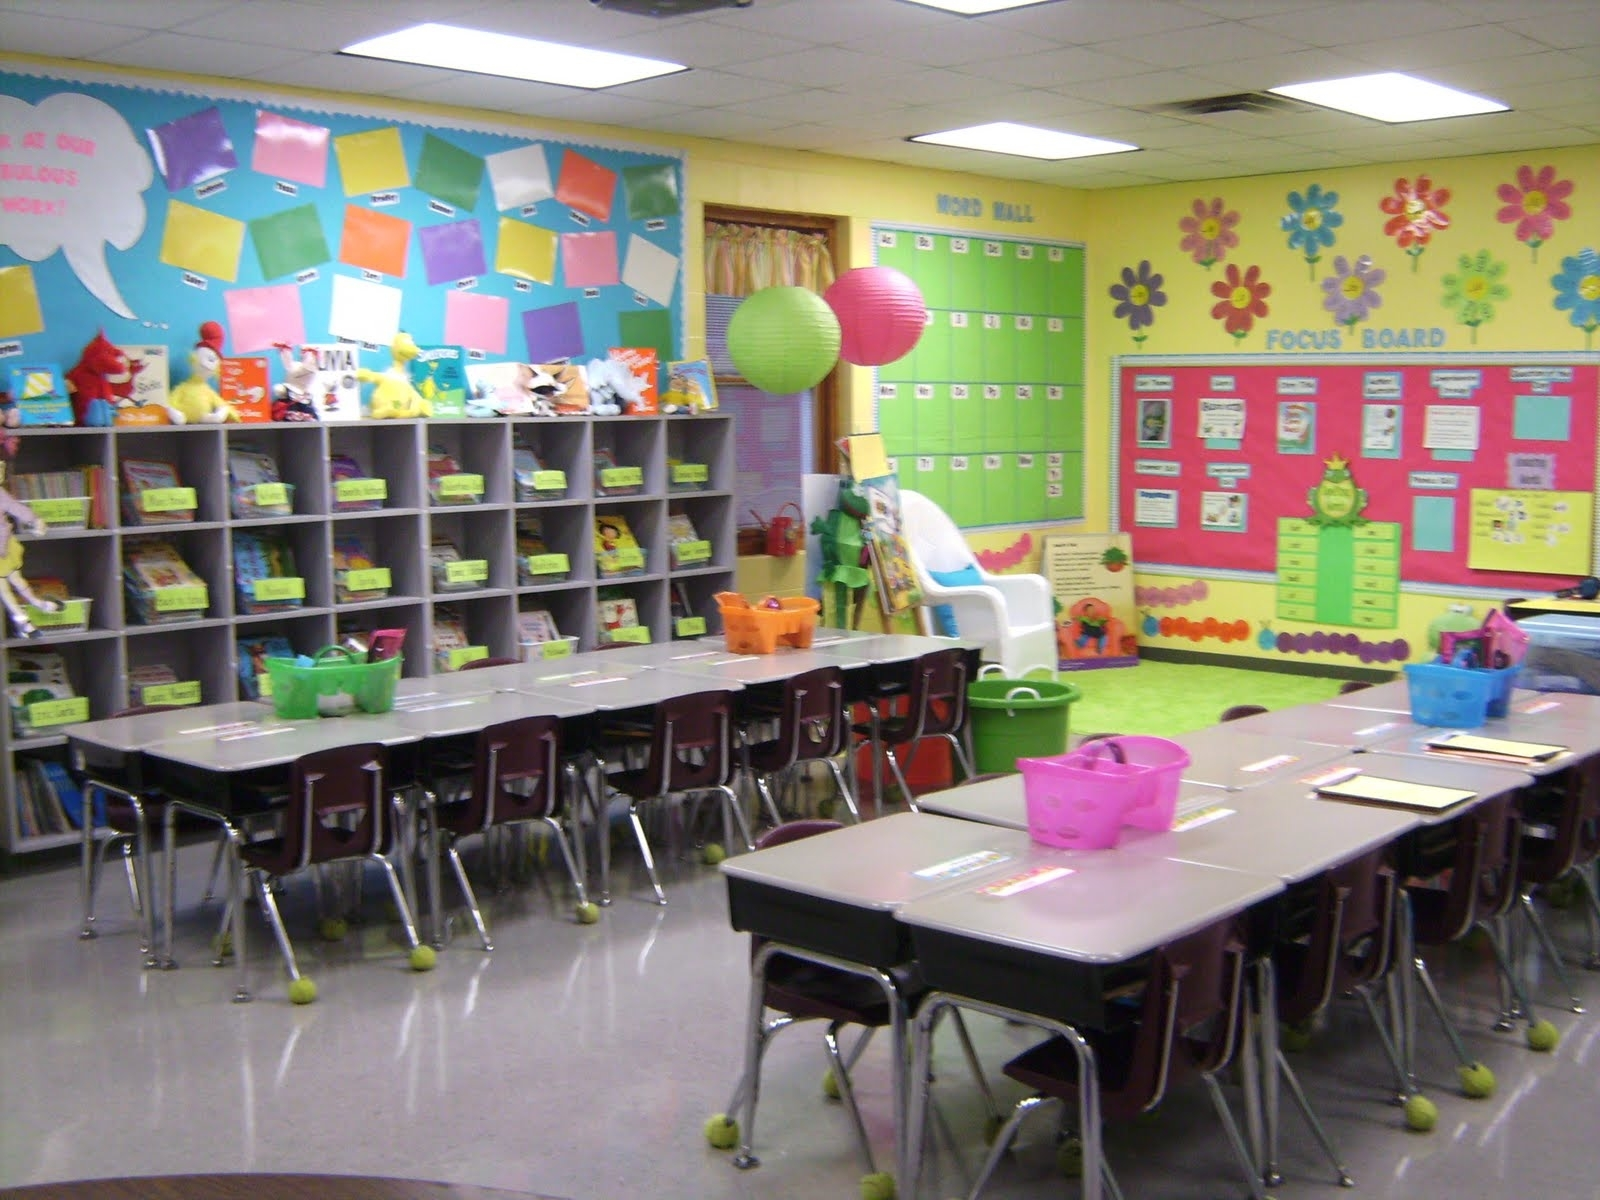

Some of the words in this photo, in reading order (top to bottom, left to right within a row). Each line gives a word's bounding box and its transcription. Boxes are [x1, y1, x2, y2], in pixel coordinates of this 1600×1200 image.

[23, 132, 47, 150] AT
[56, 133, 97, 157] OUR
[3, 197, 67, 215] WORK!
[937, 193, 982, 217] WORD
[992, 201, 1034, 222] WALL
[1267, 328, 1342, 350] FOCUS
[1361, 327, 1446, 349] BOARD
